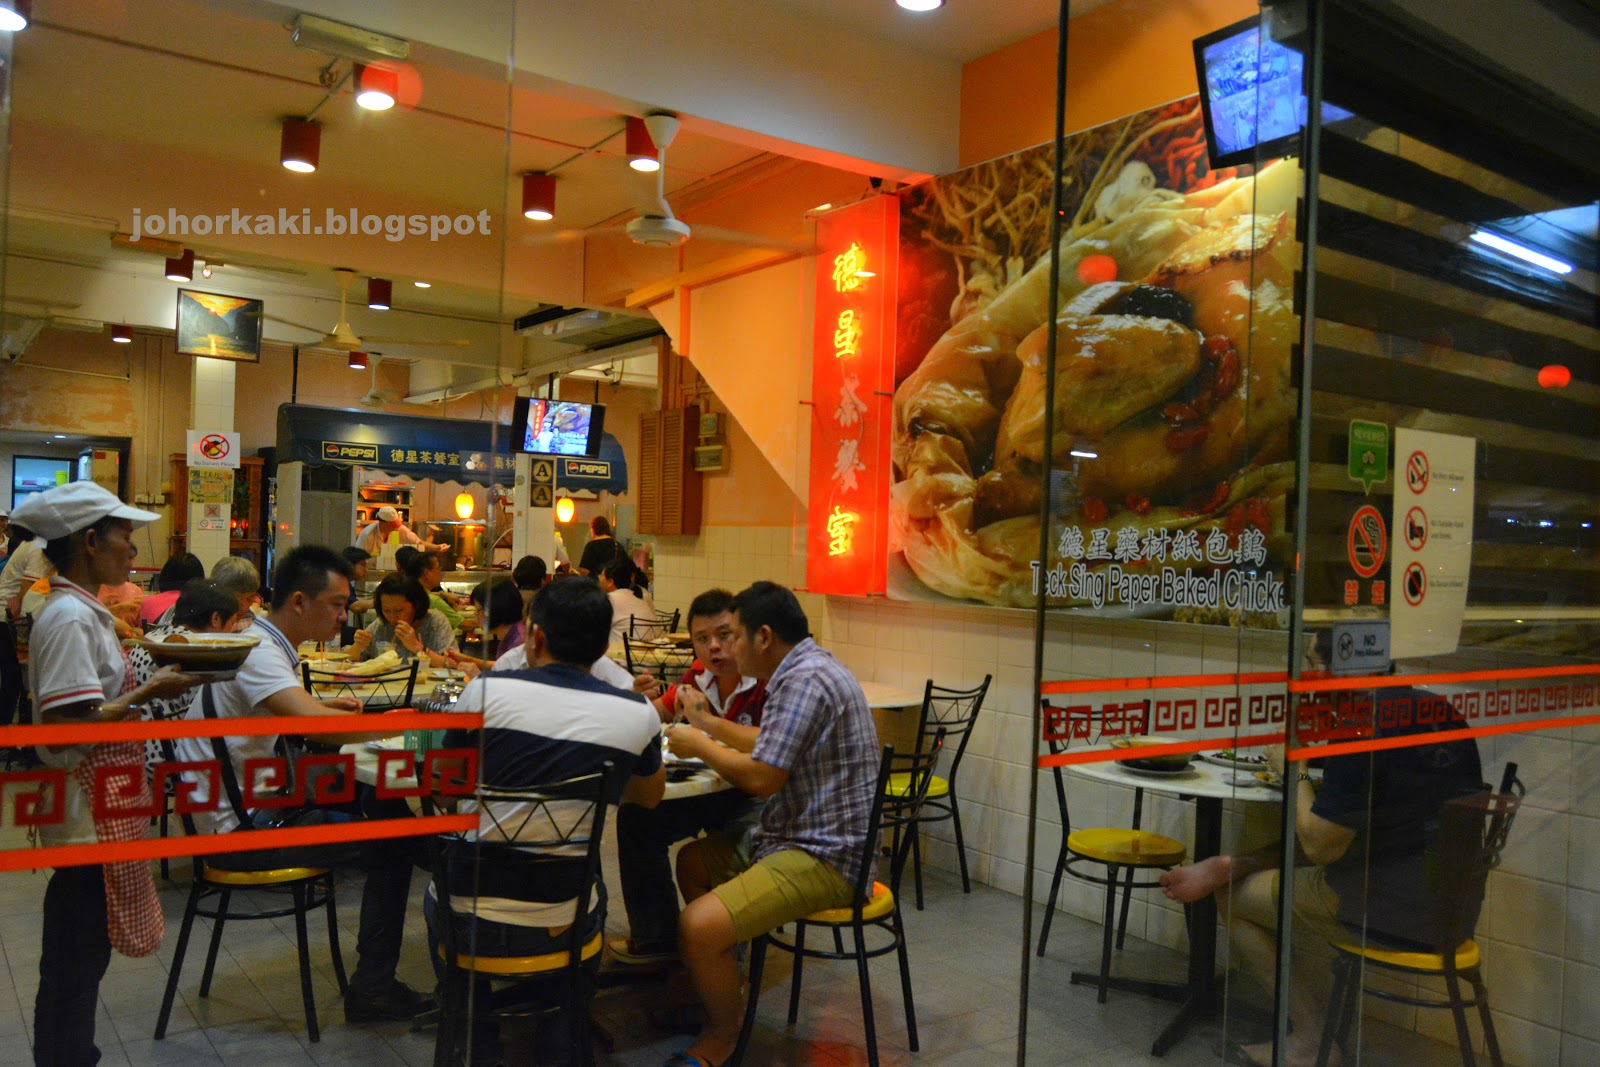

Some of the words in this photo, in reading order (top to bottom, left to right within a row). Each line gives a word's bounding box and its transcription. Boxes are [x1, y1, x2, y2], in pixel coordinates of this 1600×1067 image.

[340, 447, 376, 458] PEPSI
[391, 449, 460, 466] 德星茶餐室
[536, 464, 549, 476] A
[579, 465, 607, 474] PEPSI
[536, 488, 548, 500] A
[1069, 562, 1106, 609] Sing
[1108, 564, 1159, 611] Paper
[1162, 567, 1220, 608] Baked
[1223, 569, 1286, 612] Chicke
[1363, 634, 1376, 646] NO
